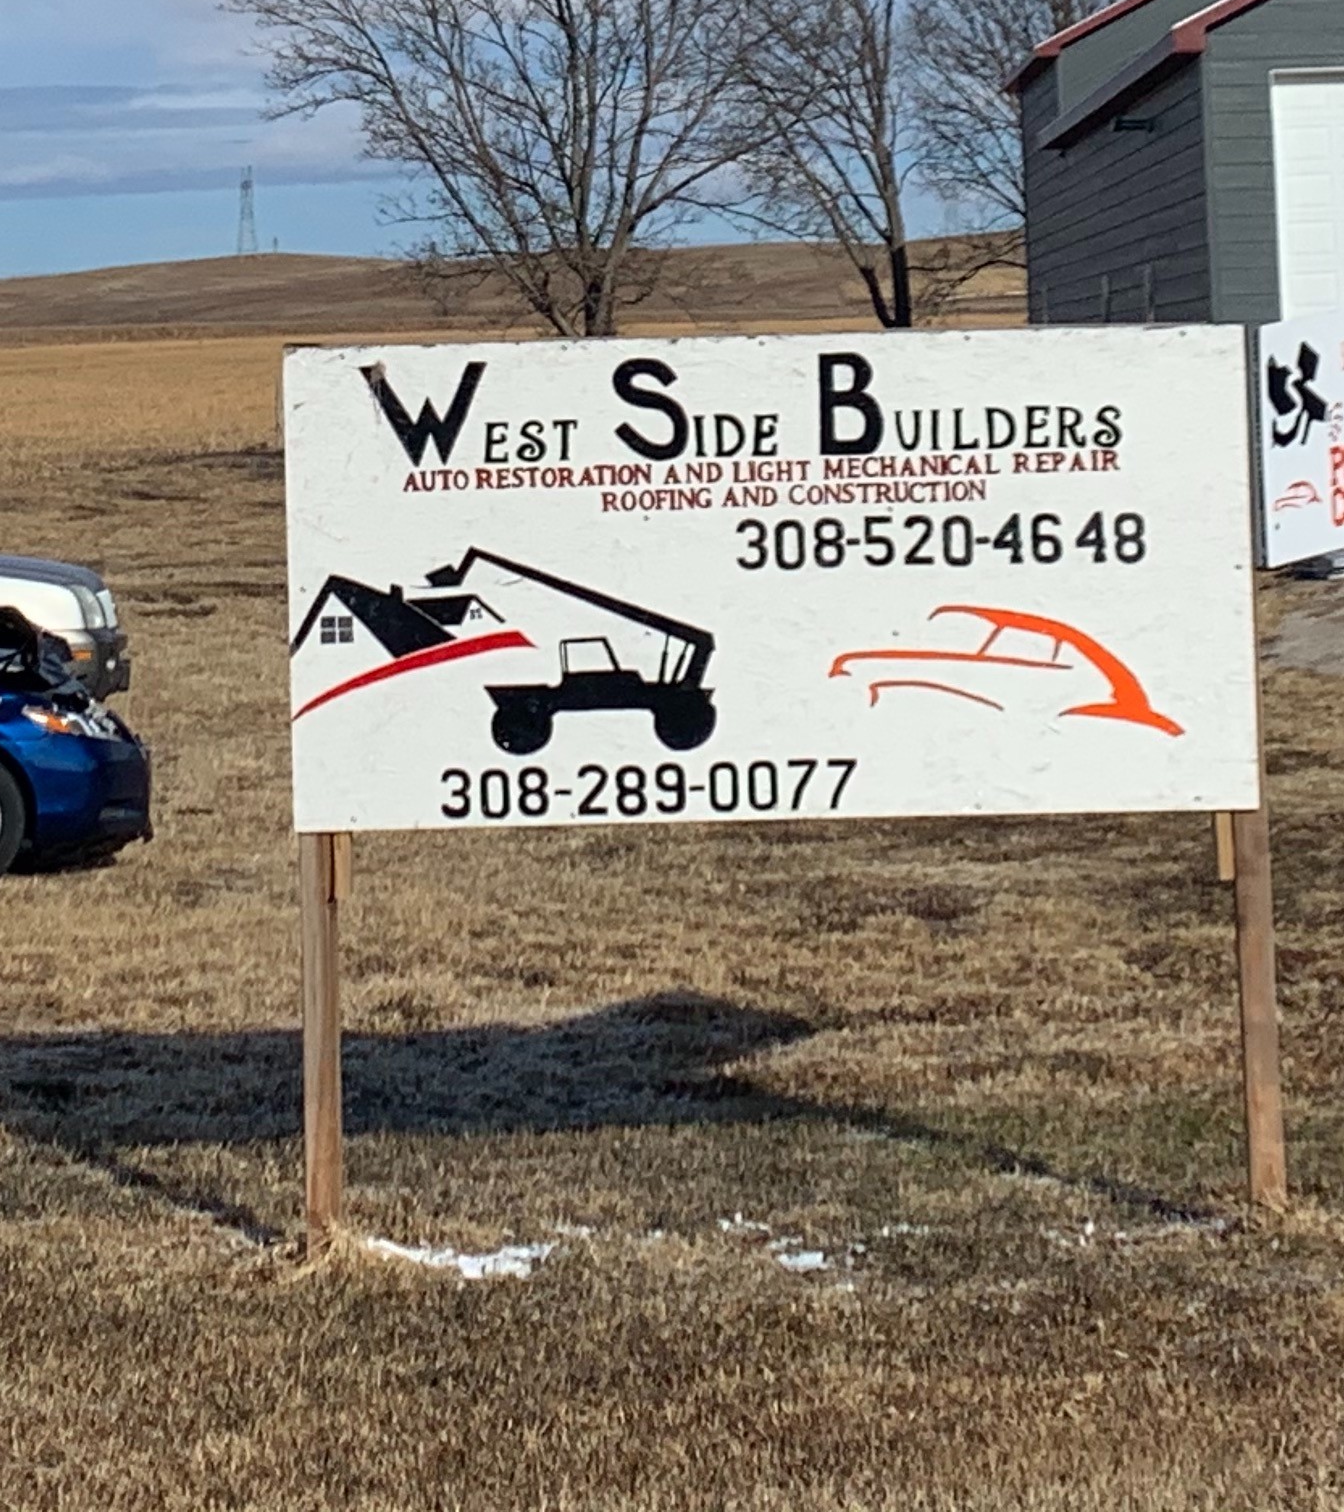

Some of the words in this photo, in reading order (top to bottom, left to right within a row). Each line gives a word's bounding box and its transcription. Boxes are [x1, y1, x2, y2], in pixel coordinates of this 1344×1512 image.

[359, 360, 578, 467] WEST
[612, 357, 779, 461] SIDE
[818, 352, 1123, 456] BUILDERS
[404, 469, 469, 492] AUTO
[474, 463, 653, 490] RESTORATION
[663, 462, 723, 485] AND
[732, 460, 811, 484] LIGHT
[823, 453, 1001, 481] MECHANICAL
[1012, 449, 1121, 474] REPAIR
[601, 488, 713, 513] ROOFING
[721, 486, 779, 508] AND
[788, 479, 988, 506] CONSTRUCTION
[735, 511, 1147, 571] 308-520-4648
[440, 758, 858, 820] 308-289-0077
